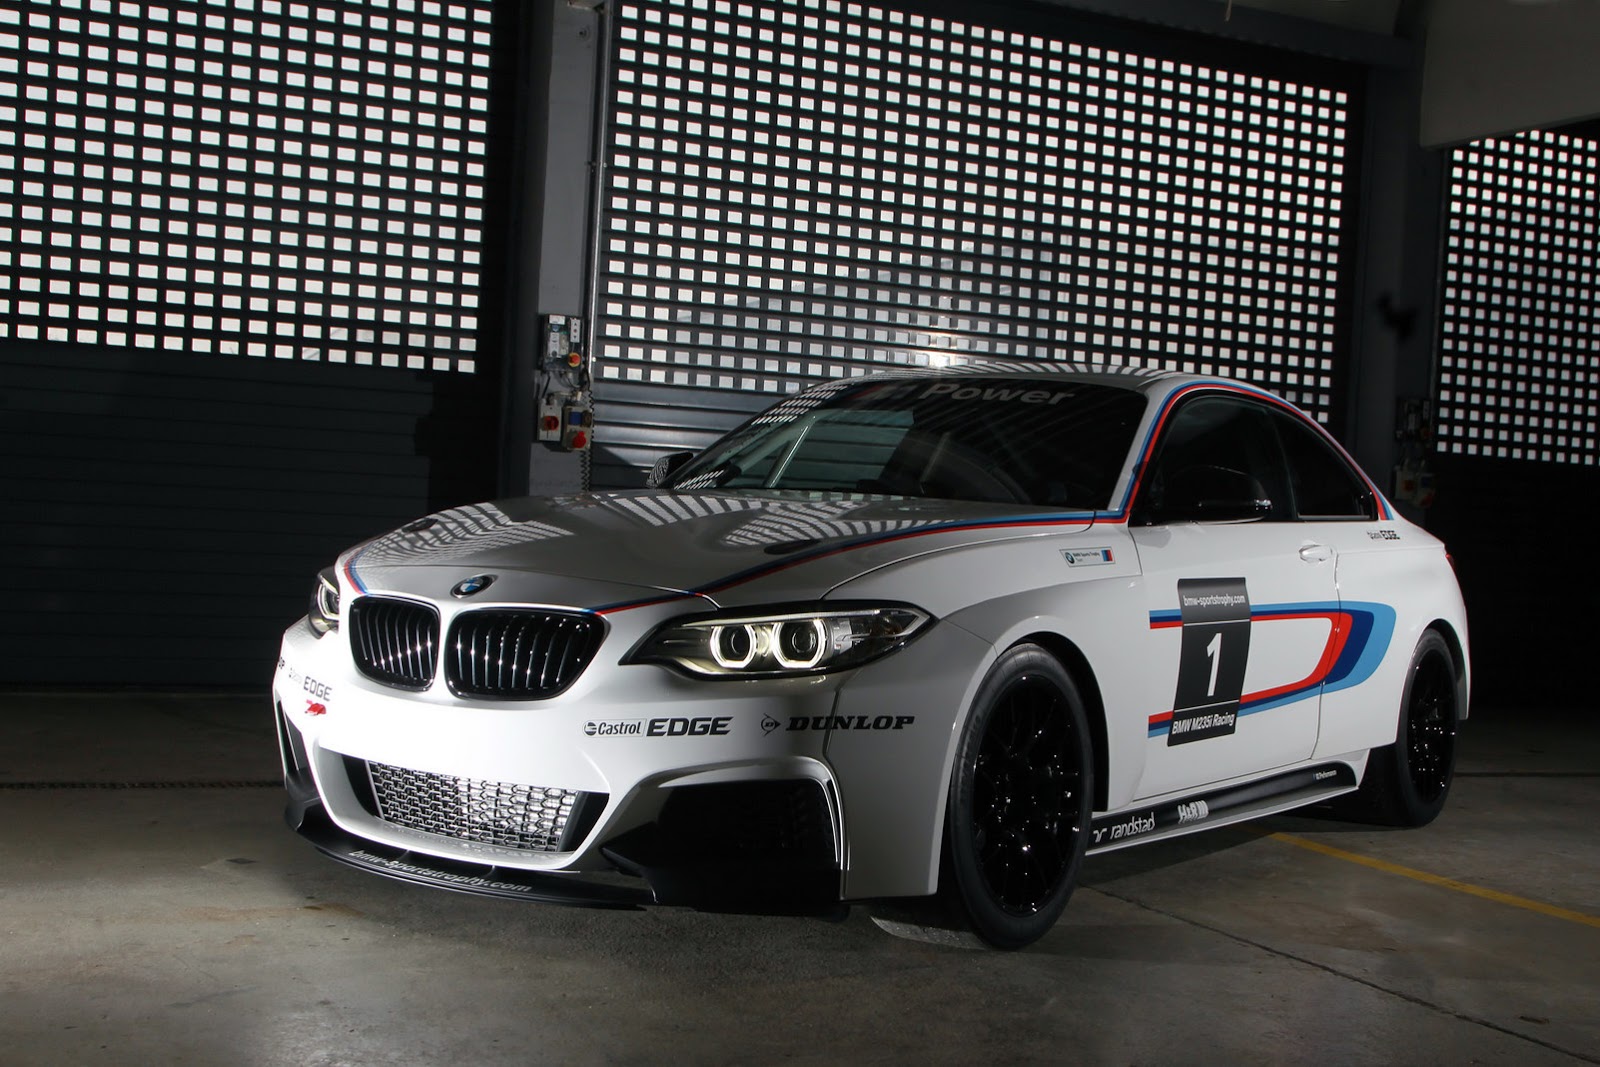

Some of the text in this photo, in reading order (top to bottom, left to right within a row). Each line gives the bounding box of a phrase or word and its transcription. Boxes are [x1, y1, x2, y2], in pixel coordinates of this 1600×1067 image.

[919, 383, 1075, 405] Power
[1183, 593, 1246, 607] bmw-sportstrophy.com
[1207, 633, 1222, 696] 1
[303, 676, 333, 702] EDGE
[598, 716, 734, 737] Castrol EDGE
[785, 716, 915, 731] DUNLOP
[1172, 719, 1192, 734] BMW
[1212, 711, 1236, 727] Racing
[1110, 811, 1156, 840] randstad
